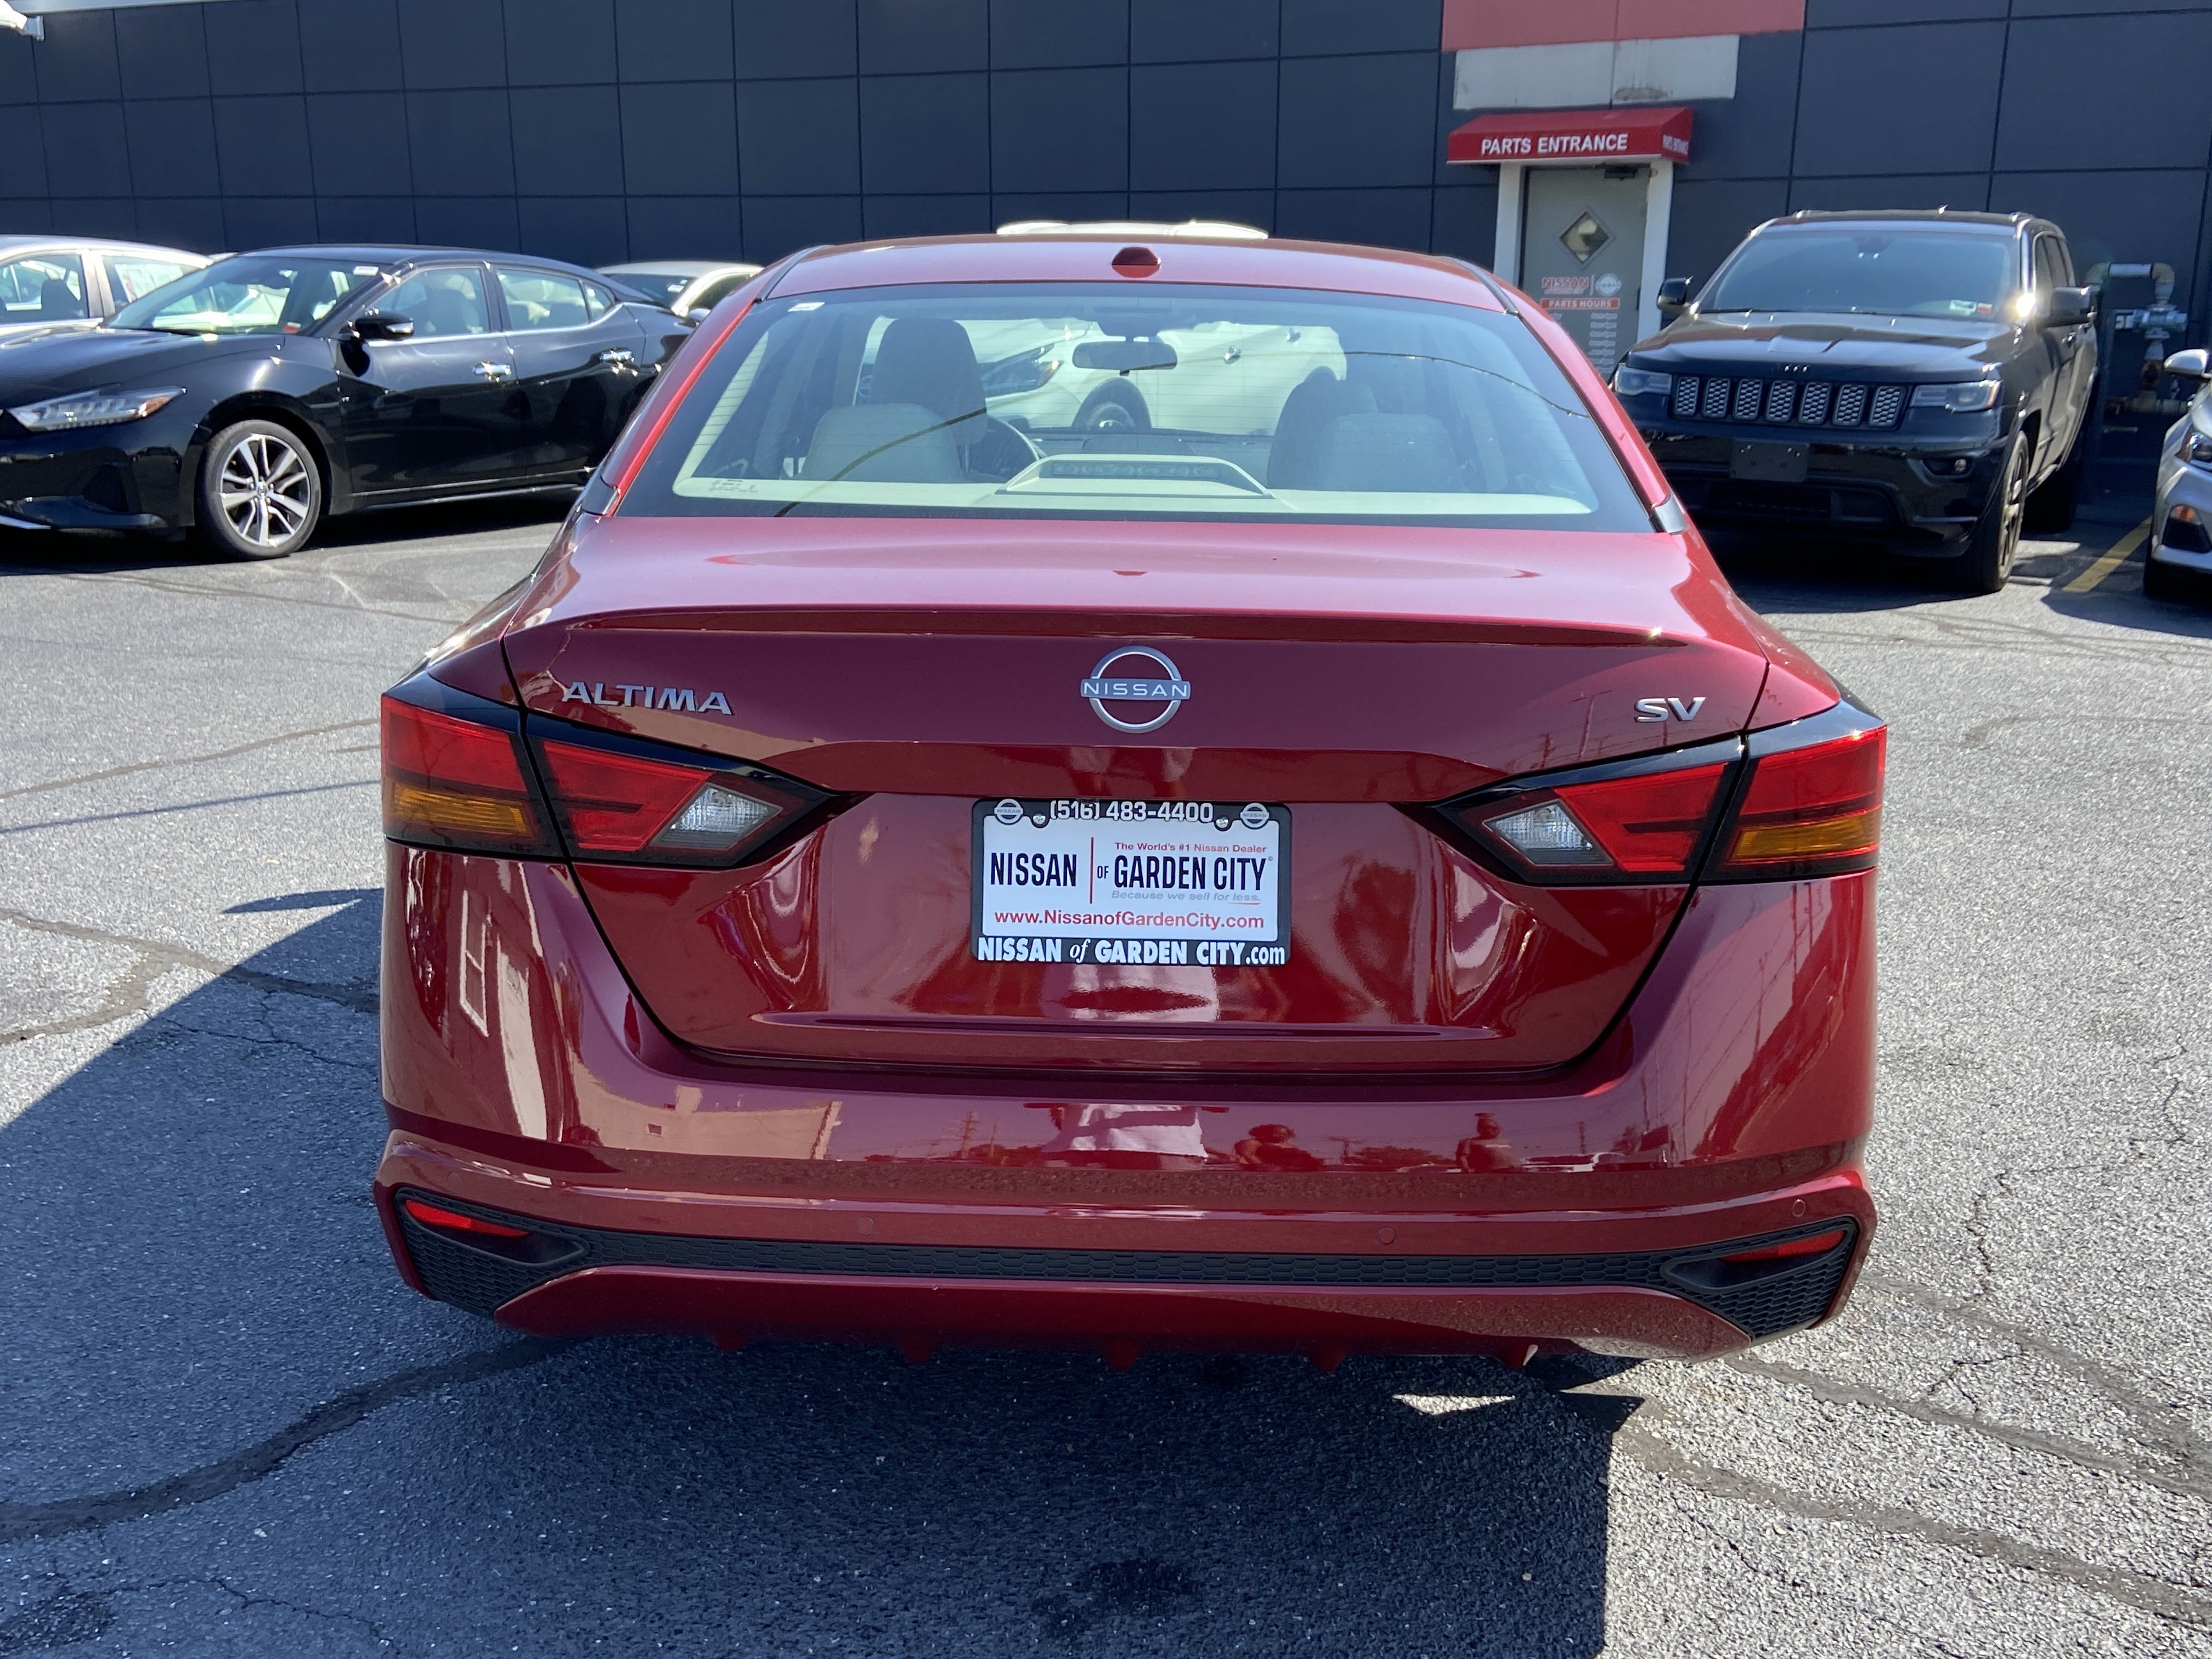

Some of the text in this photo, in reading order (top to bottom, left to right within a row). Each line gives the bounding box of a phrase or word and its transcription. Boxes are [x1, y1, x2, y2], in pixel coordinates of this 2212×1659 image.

[1481, 133, 1629, 155] PARTS ENTRANCE
[1542, 276, 1589, 288] NISSAN
[1549, 300, 1611, 308] PARTS HOURS
[561, 681, 733, 716] ALTIMA
[1084, 682, 1187, 697] NISSAN
[1635, 697, 1707, 723] SV
[1050, 800, 1214, 823] (516) 483-4400
[1115, 842, 1267, 853] The World's #1 Nissan Dealer
[990, 852, 1077, 887] NISSAN
[1097, 855, 1266, 890] OF GARDEN CITY
[1111, 890, 1163, 900] Because
[1189, 892, 1210, 901] sell
[1214, 892, 1229, 901] for
[995, 910, 1264, 930] www.NissanofGardenCity.com
[978, 936, 1285, 965] NISSAN of GARDEN CITY.com
